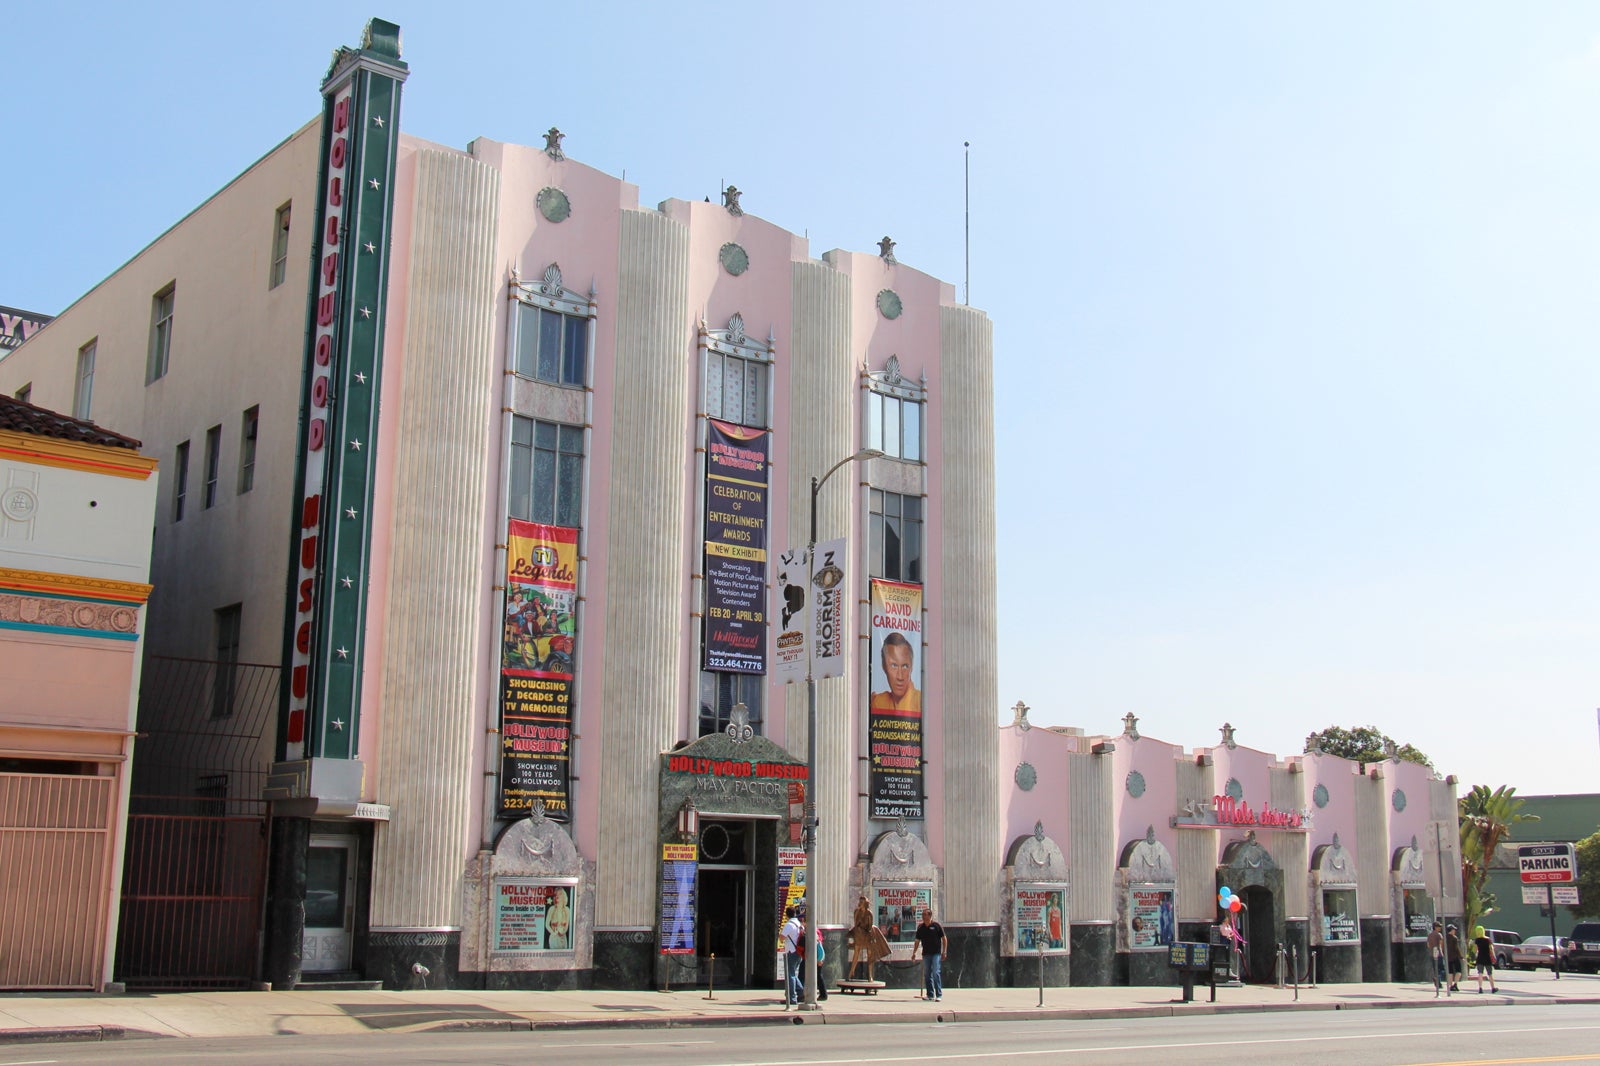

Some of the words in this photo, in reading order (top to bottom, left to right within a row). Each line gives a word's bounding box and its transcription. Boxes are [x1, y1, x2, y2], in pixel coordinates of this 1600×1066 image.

[309, 96, 348, 450] HOLLYWOOD
[711, 442, 764, 462] HOLLYWOOD
[719, 455, 756, 471] MUSEUM
[713, 485, 761, 502] CELEBRATION
[732, 502, 741, 511] OF
[709, 511, 764, 529] ENTERTAINMENT
[723, 528, 750, 542] AWARDS
[535, 549, 551, 564] TV
[715, 545, 729, 553] NEW
[732, 547, 757, 557] EXHIBIT
[510, 557, 573, 581] Legends
[718, 570, 728, 578] Best
[722, 562, 750, 573] Showcasing
[713, 578, 730, 587] Motion
[732, 580, 747, 588] Picture
[716, 587, 739, 597] Television
[741, 590, 756, 599] Award
[816, 592, 823, 604] OF
[722, 597, 750, 607] Contenders
[709, 607, 721, 617] FEB
[723, 608, 731, 618] 20
[736, 609, 752, 621] APRIL
[753, 611, 762, 623] 30
[885, 602, 911, 617] DAVID
[287, 493, 319, 742] MUSEUM
[873, 614, 920, 632] CARRADINE
[709, 657, 762, 670] 323.464.7776
[783, 653, 793, 662] MAY
[509, 679, 566, 691] SHOWCASING
[506, 690, 512, 698] 7
[517, 691, 553, 701] DECADES
[557, 694, 568, 702] OF
[505, 702, 516, 710] TV
[520, 703, 567, 714] MEMORIES!
[872, 719, 878, 727] A
[503, 723, 569, 739] HOLLYWOOD
[873, 731, 910, 741] RENAISSANCE
[513, 738, 561, 752] MUSEUM
[872, 743, 921, 756] HOLLYWOOD
[517, 762, 557, 770] SHOWCASING
[669, 755, 751, 777] HOLLYWOOD
[755, 763, 808, 780] MUSEUM
[881, 755, 916, 768] MUSEUM
[696, 777, 726, 792] MAX
[735, 780, 781, 794] FACTOR
[874, 806, 920, 816] 323.464.7776
[1212, 795, 1257, 824] Mels
[1521, 858, 1569, 870] PARKING
[878, 889, 916, 897] HOLLYWOOD
[509, 896, 547, 905] MUSEUM
